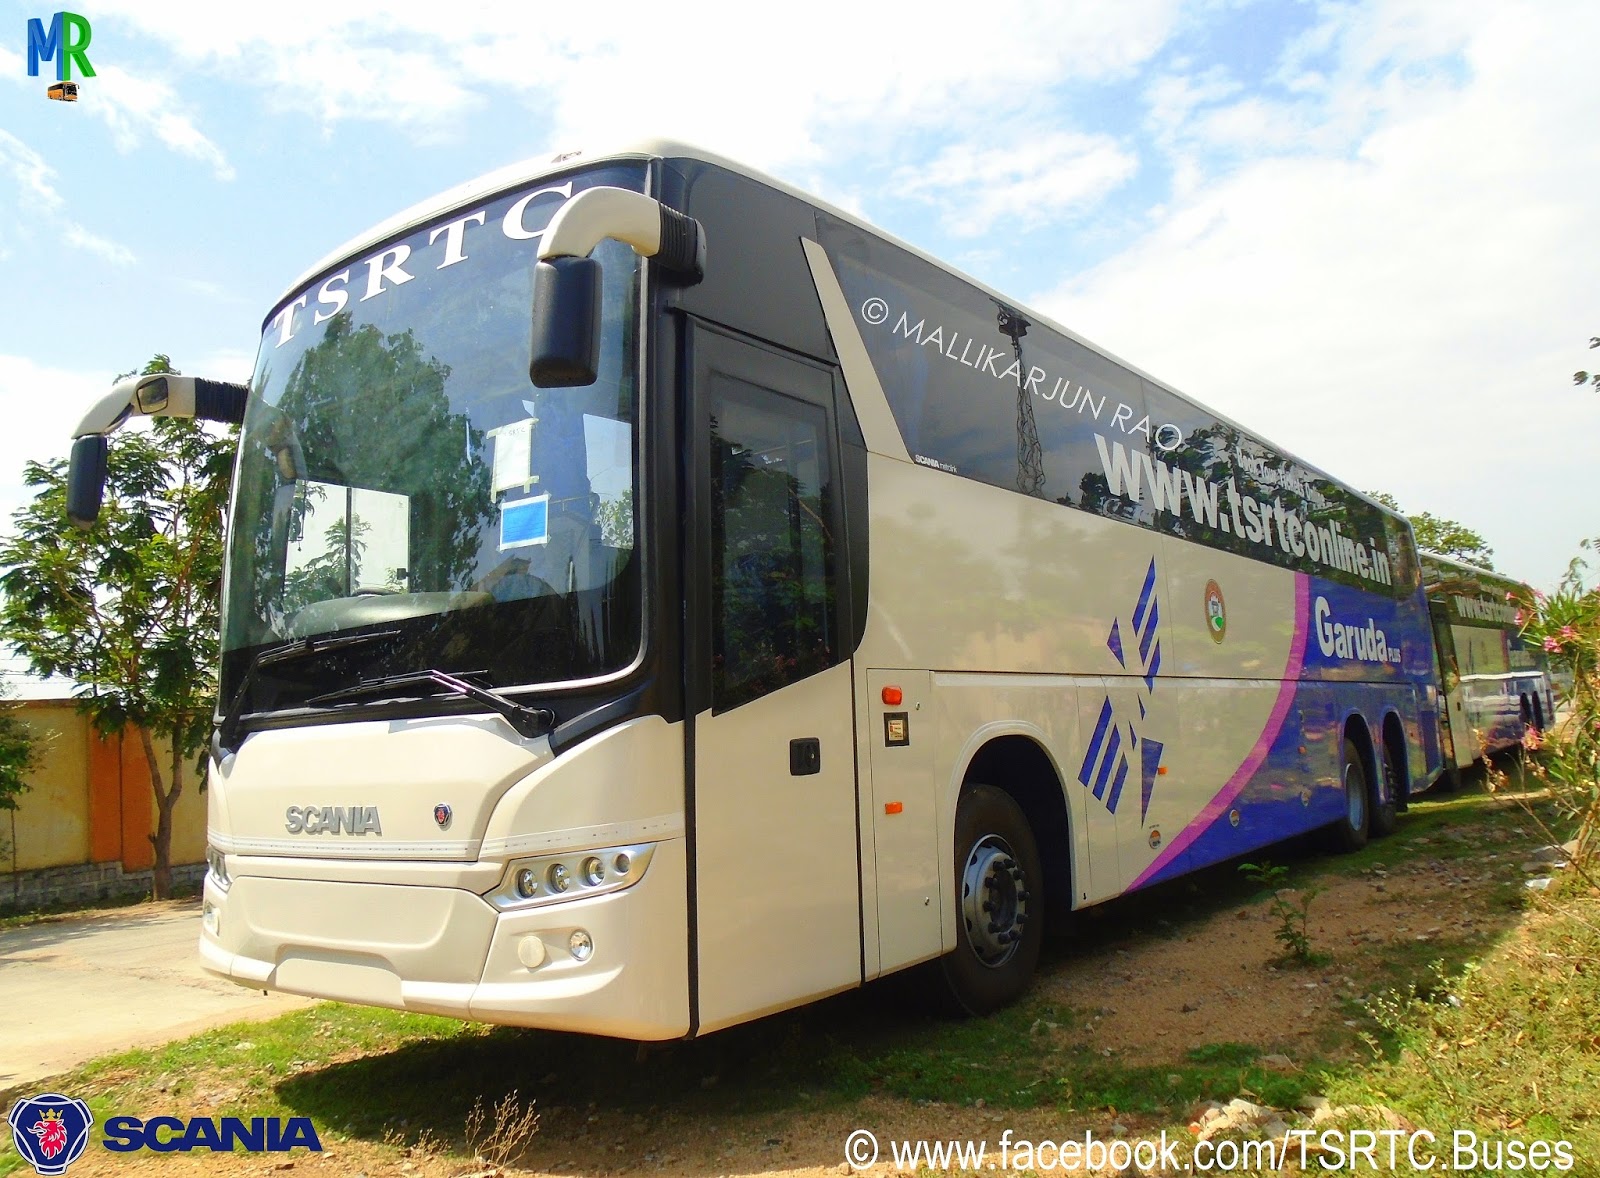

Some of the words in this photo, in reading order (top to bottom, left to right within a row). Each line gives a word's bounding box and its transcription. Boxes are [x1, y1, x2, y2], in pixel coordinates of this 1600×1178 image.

[273, 181, 573, 349] TSRTC
[915, 454, 940, 468] SCANIA
[1094, 432, 1392, 586] www.tsrtconline.in
[1315, 596, 1388, 661] Garuda
[285, 805, 382, 836] SCANIA
